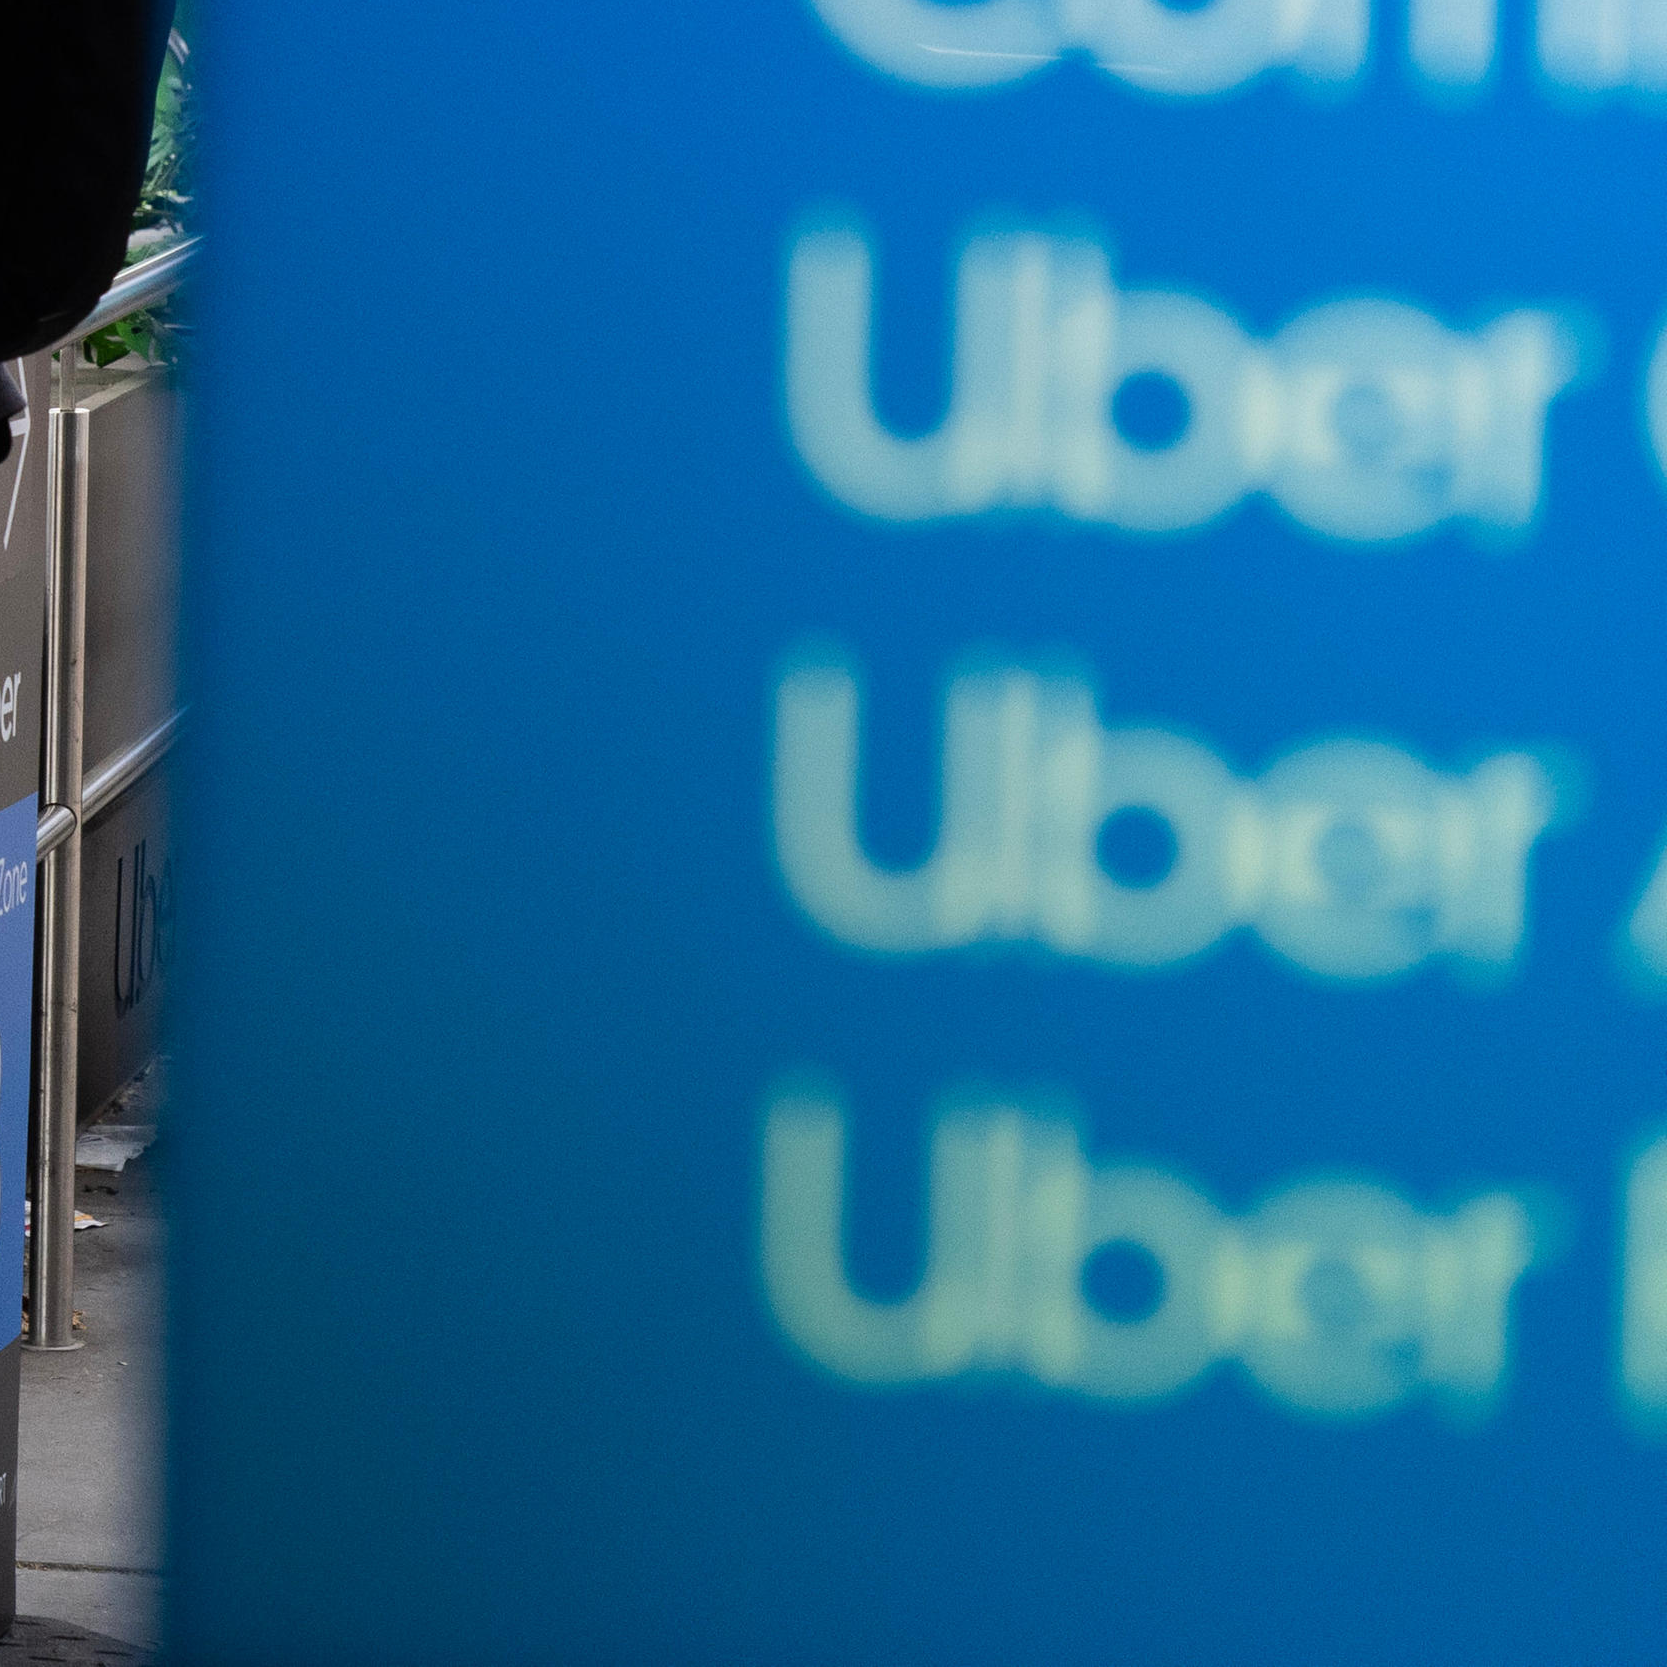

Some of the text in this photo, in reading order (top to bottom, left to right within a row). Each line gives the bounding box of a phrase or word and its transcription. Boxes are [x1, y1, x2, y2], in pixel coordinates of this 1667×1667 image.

[785, 228, 1592, 541] Uber
[773, 668, 1572, 978] Uber
[762, 1103, 1552, 1408] Uber
